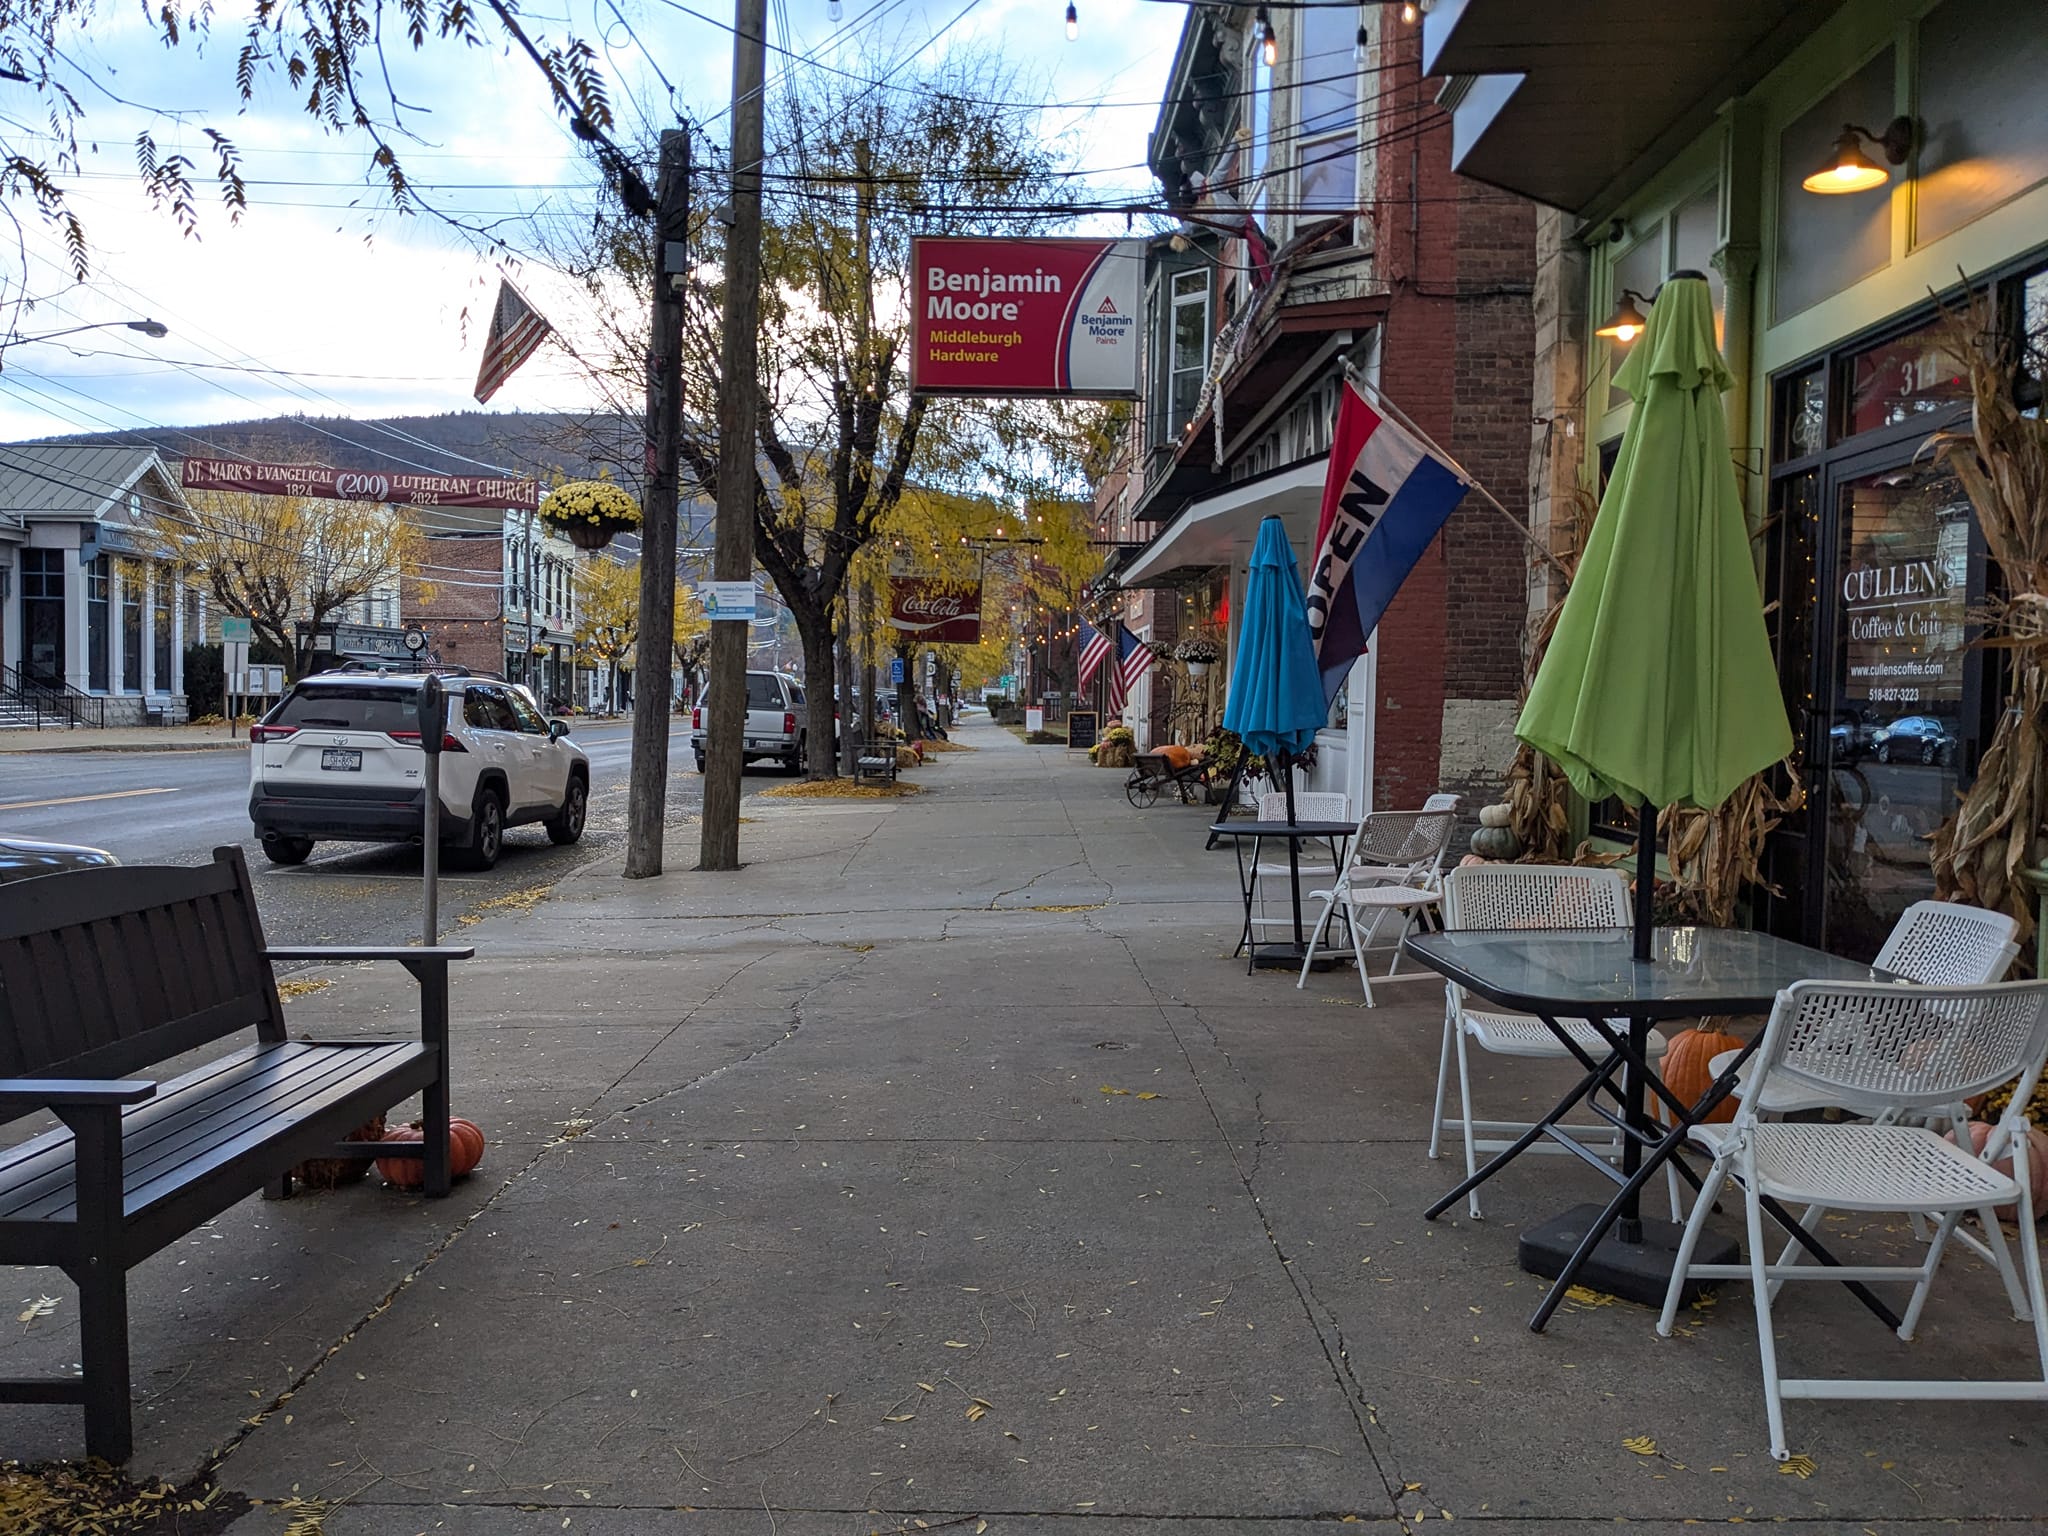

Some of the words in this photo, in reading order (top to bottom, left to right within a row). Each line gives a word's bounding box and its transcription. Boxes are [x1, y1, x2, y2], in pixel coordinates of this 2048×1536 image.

[928, 267, 1061, 298] Benjamin
[1081, 315, 1132, 327] Benjamin
[930, 330, 1022, 347] Middleburgh
[1089, 326, 1125, 336] Moore
[1095, 337, 1118, 345] Paints
[929, 349, 999, 362] Hardware
[1900, 352, 1938, 397] 314
[187, 460, 204, 483] ST.
[209, 462, 252, 481] MARK'S
[256, 466, 334, 484] EVANGELICAL
[345, 474, 381, 495] 200
[393, 475, 470, 495] LUTHERAN
[477, 479, 536, 505] CHURCH
[285, 483, 313, 497] 1824
[410, 491, 439, 506] 2024
[1307, 469, 1391, 641] OPEN
[1844, 557, 1956, 602] CULLEN'S
[1852, 614, 1892, 640] Coffee
[1895, 612, 1905, 637] &
[1850, 660, 1944, 677] www.cullenscoffee.com
[1868, 686, 1920, 702] 518-827-3223
